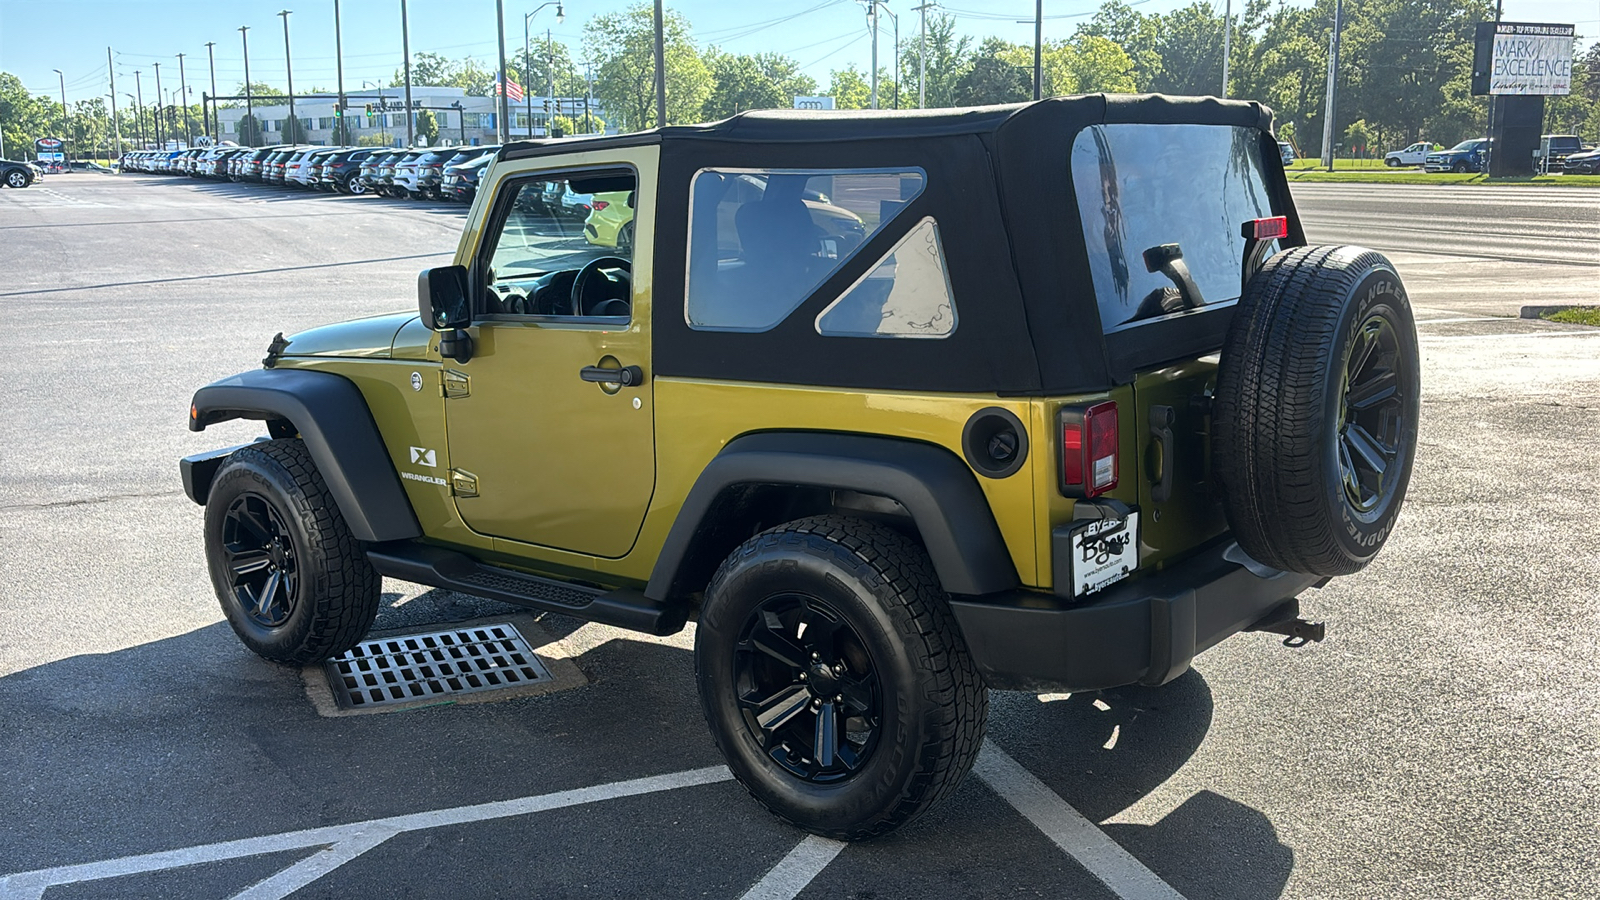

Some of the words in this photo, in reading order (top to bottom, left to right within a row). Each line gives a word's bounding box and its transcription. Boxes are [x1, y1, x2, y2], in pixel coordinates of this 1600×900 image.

[1495, 40, 1533, 58] MARK
[1494, 58, 1570, 77] EXCELLENCE
[217, 468, 273, 490] COOPER
[401, 471, 447, 487] WRANGLER
[1088, 518, 1121, 537] BYER
